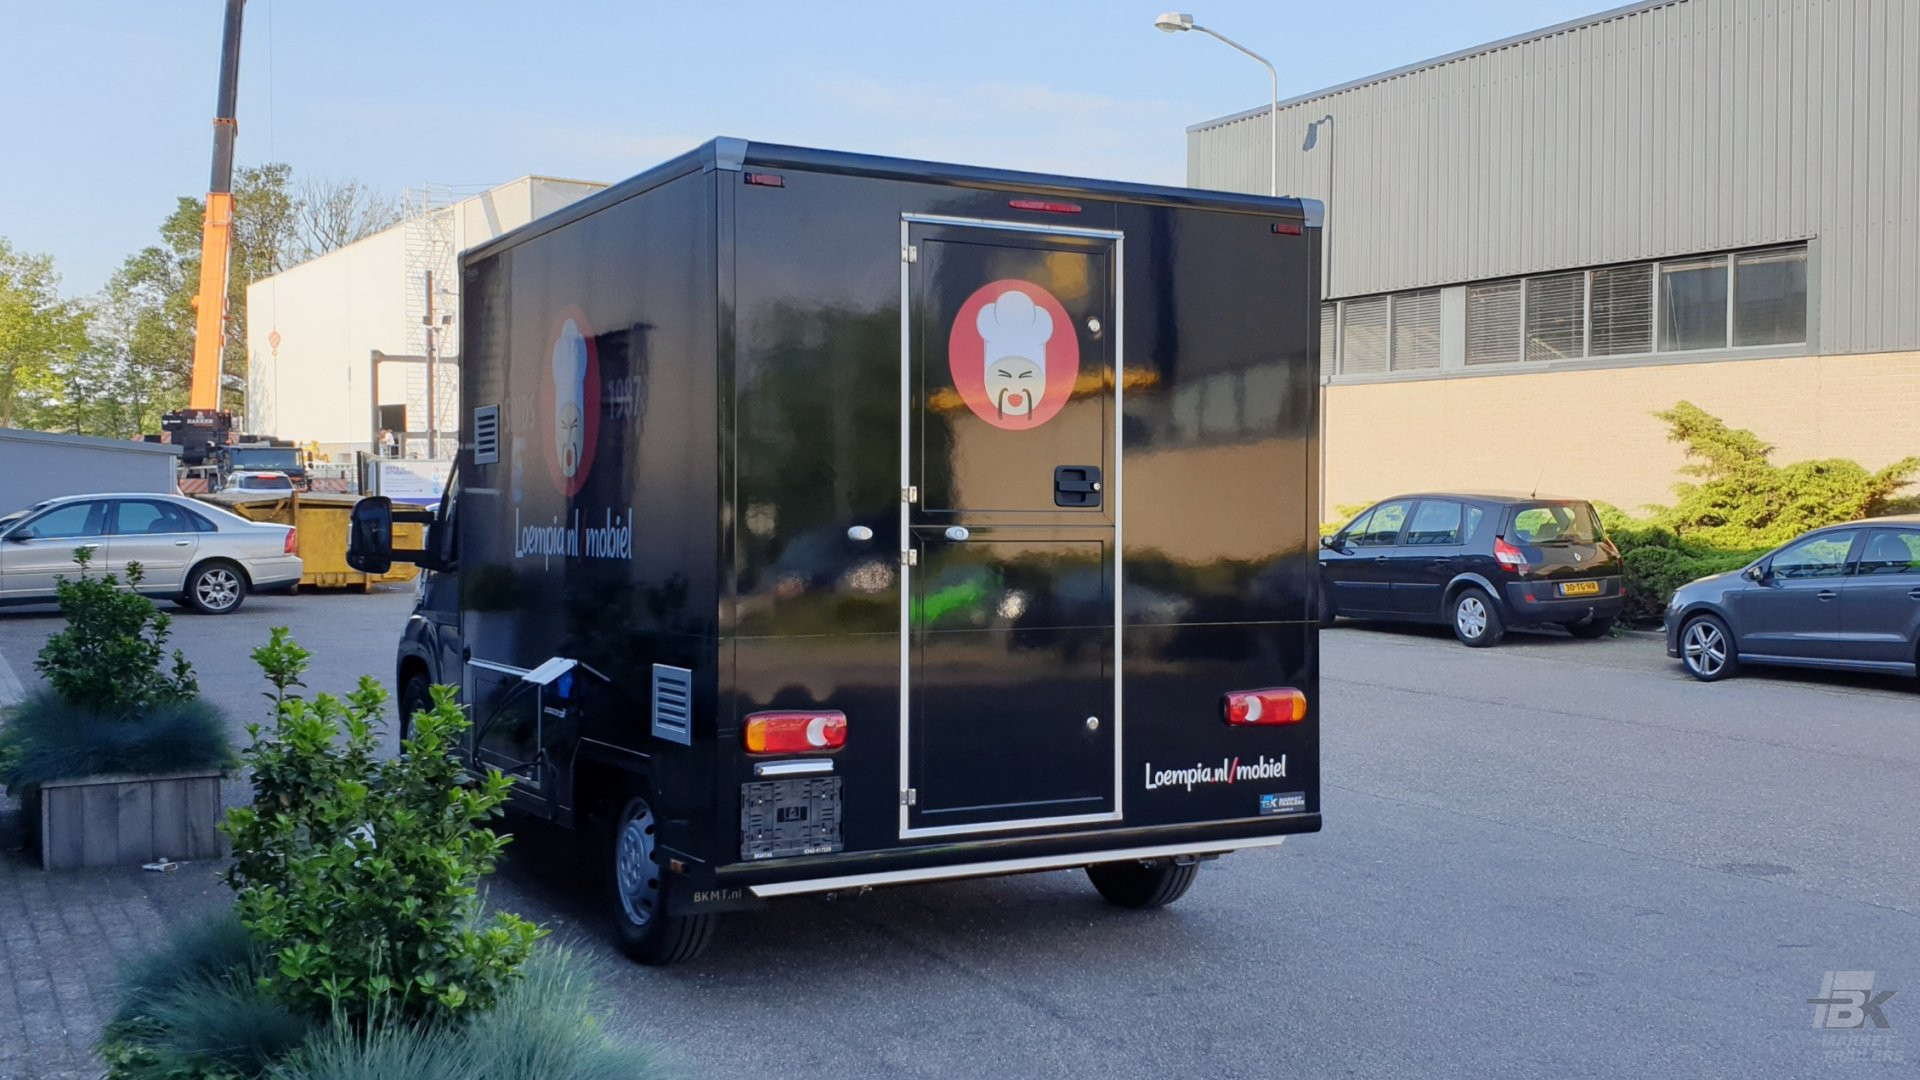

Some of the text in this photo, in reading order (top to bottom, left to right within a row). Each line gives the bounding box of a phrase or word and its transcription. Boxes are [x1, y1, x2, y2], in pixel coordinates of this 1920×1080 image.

[608, 375, 642, 420] 1987
[515, 507, 632, 571] Loempianl/mobiel
[1145, 754, 1287, 792] Loempia.nl/mobiel
[693, 889, 742, 903] BKMT.nl
